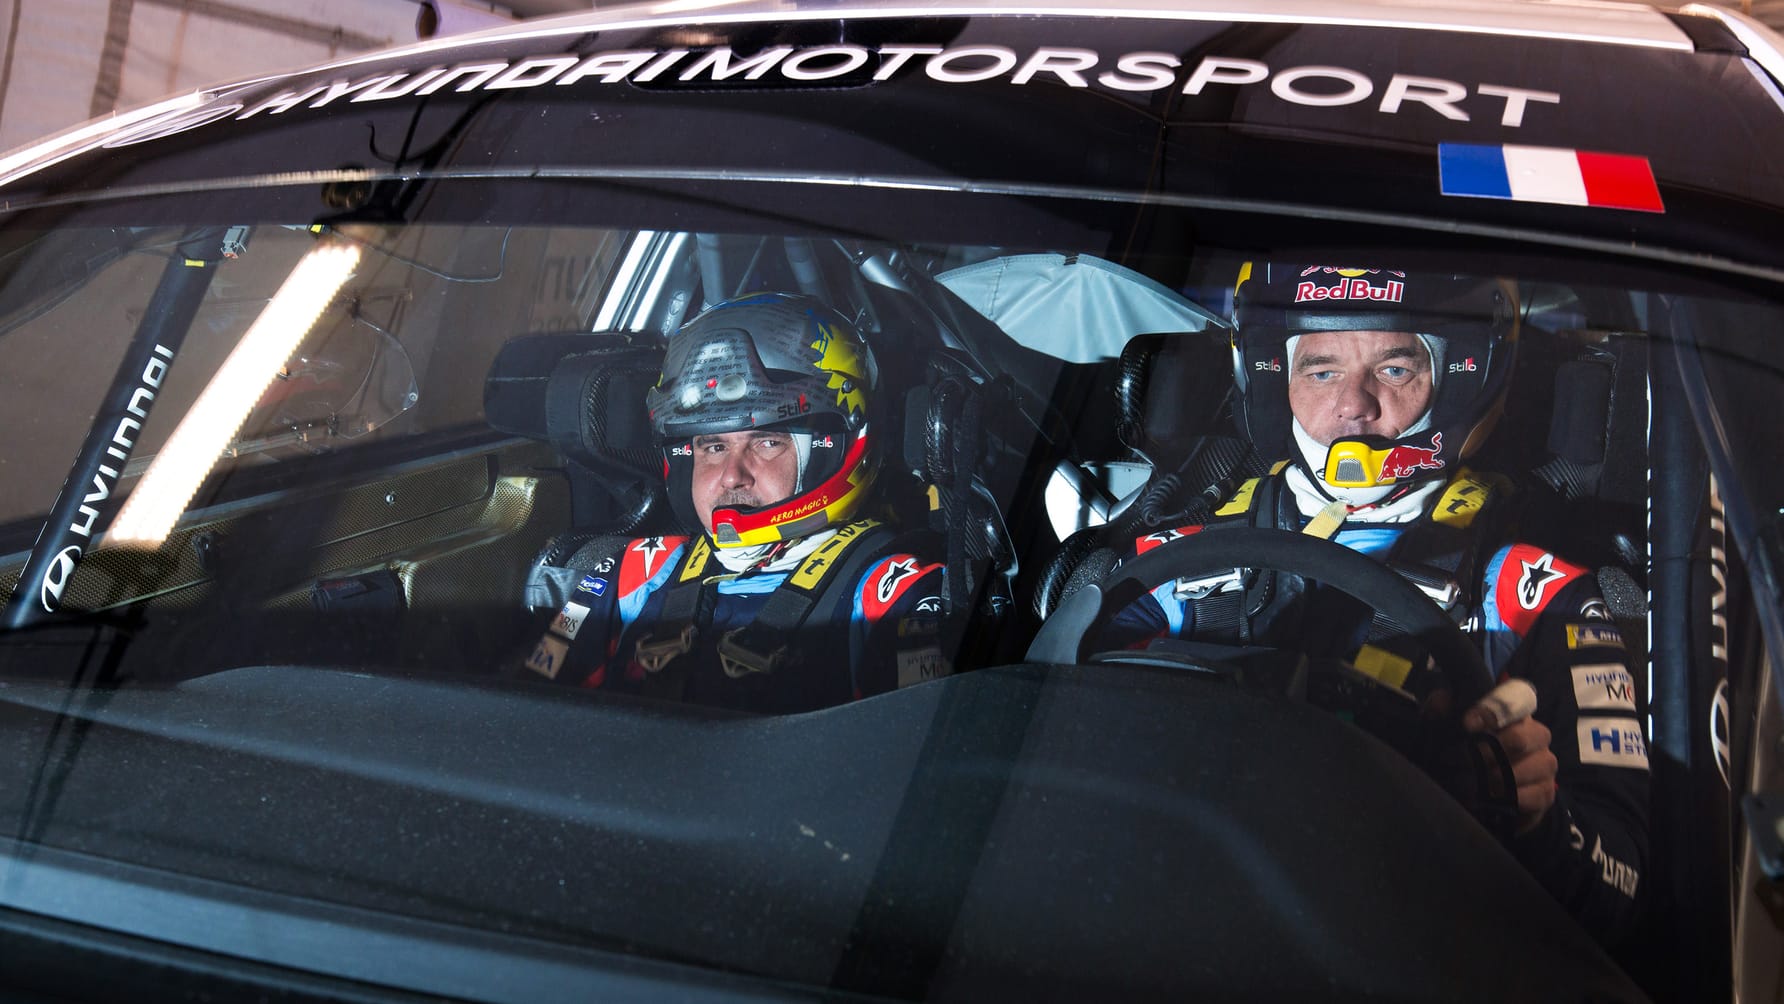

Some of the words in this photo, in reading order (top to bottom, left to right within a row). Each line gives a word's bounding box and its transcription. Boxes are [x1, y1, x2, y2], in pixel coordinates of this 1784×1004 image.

[235, 50, 675, 120] HYUNDAI
[679, 43, 1561, 128] MOTORSPORT
[1294, 277, 1350, 303] Red
[1348, 278, 1404, 303] Bull
[777, 395, 811, 418] Stilo
[770, 510, 794, 524] AERO
[794, 499, 821, 517] MAGIC
